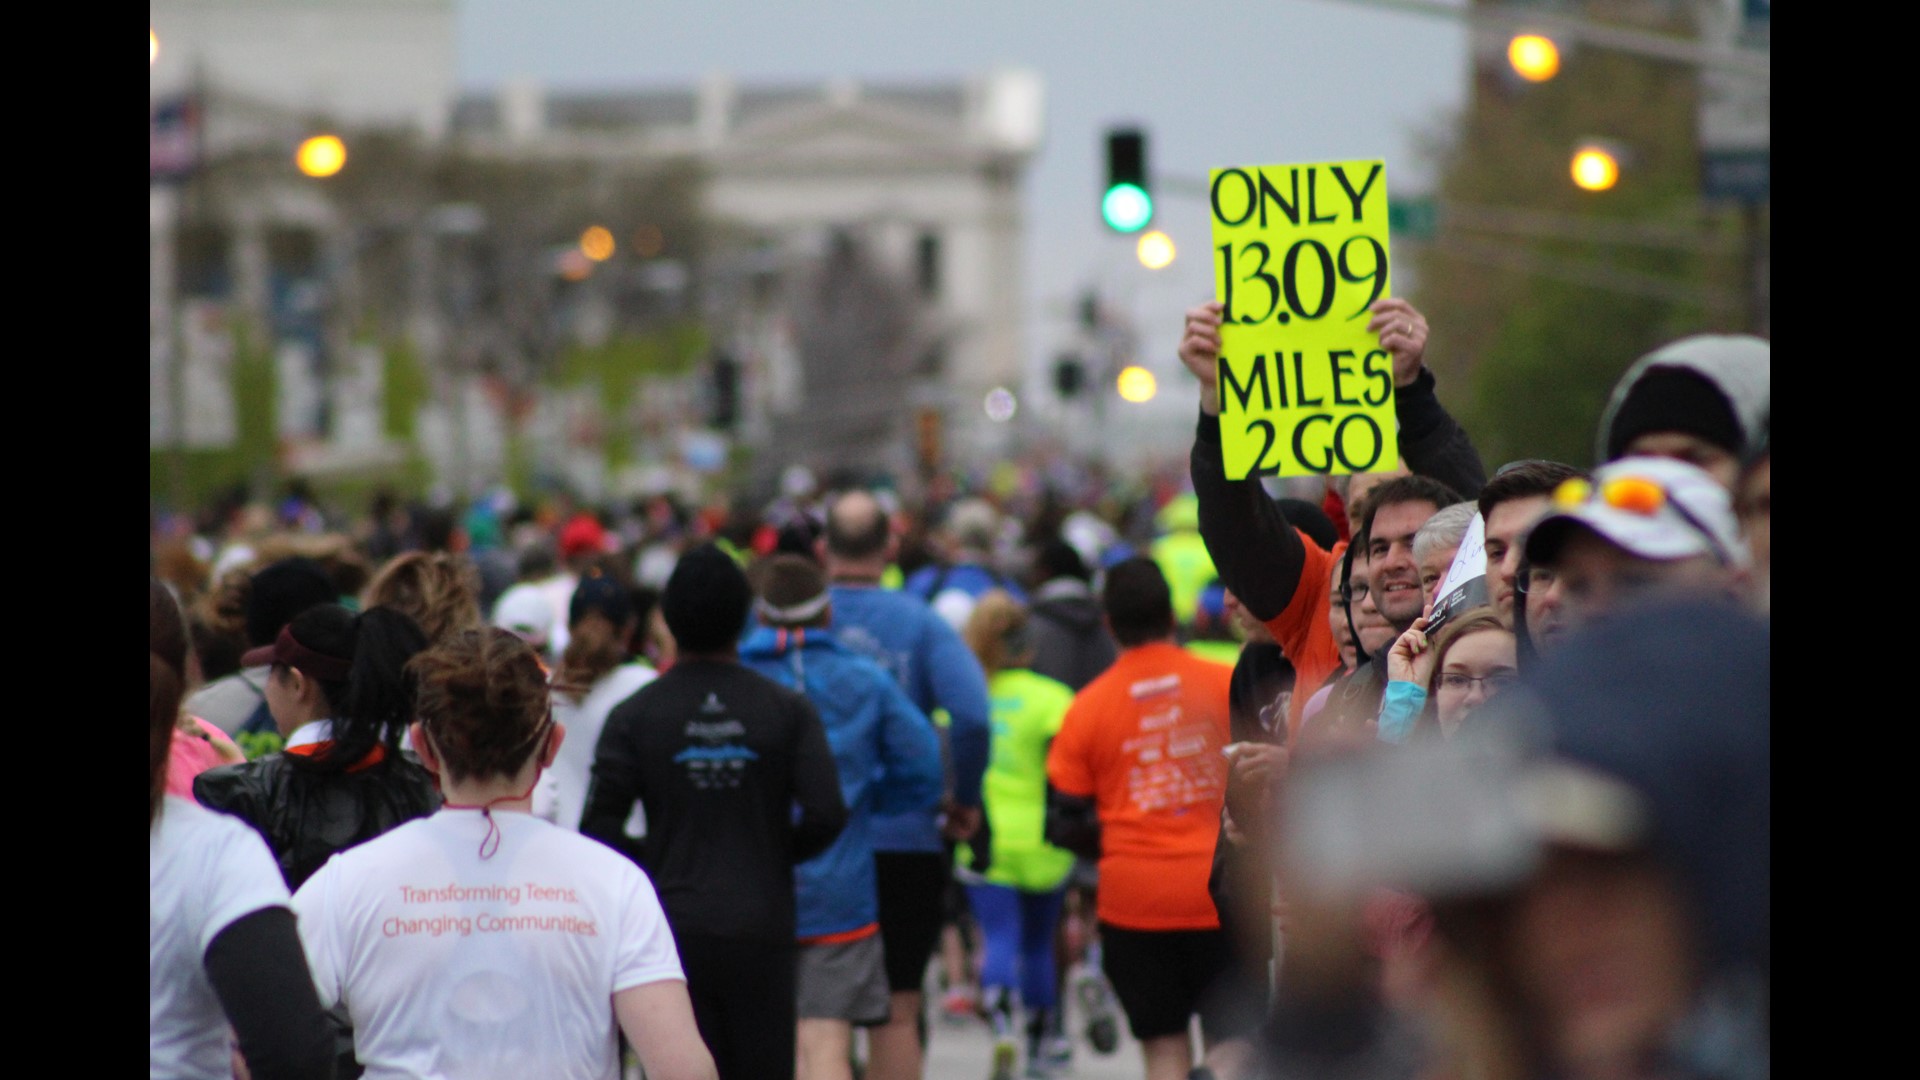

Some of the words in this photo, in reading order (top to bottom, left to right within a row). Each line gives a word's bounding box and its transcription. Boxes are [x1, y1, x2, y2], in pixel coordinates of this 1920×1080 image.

[1211, 164, 1383, 229] ONLY
[1216, 235, 1388, 325] 13.09
[1218, 350, 1392, 414] MILES
[1245, 419, 1281, 480] 2
[1291, 413, 1383, 475] GO
[382, 914, 472, 938] Changing
[476, 912, 598, 937] Communities.
[400, 882, 521, 905] Transforming
[525, 883, 579, 903] Teens.
